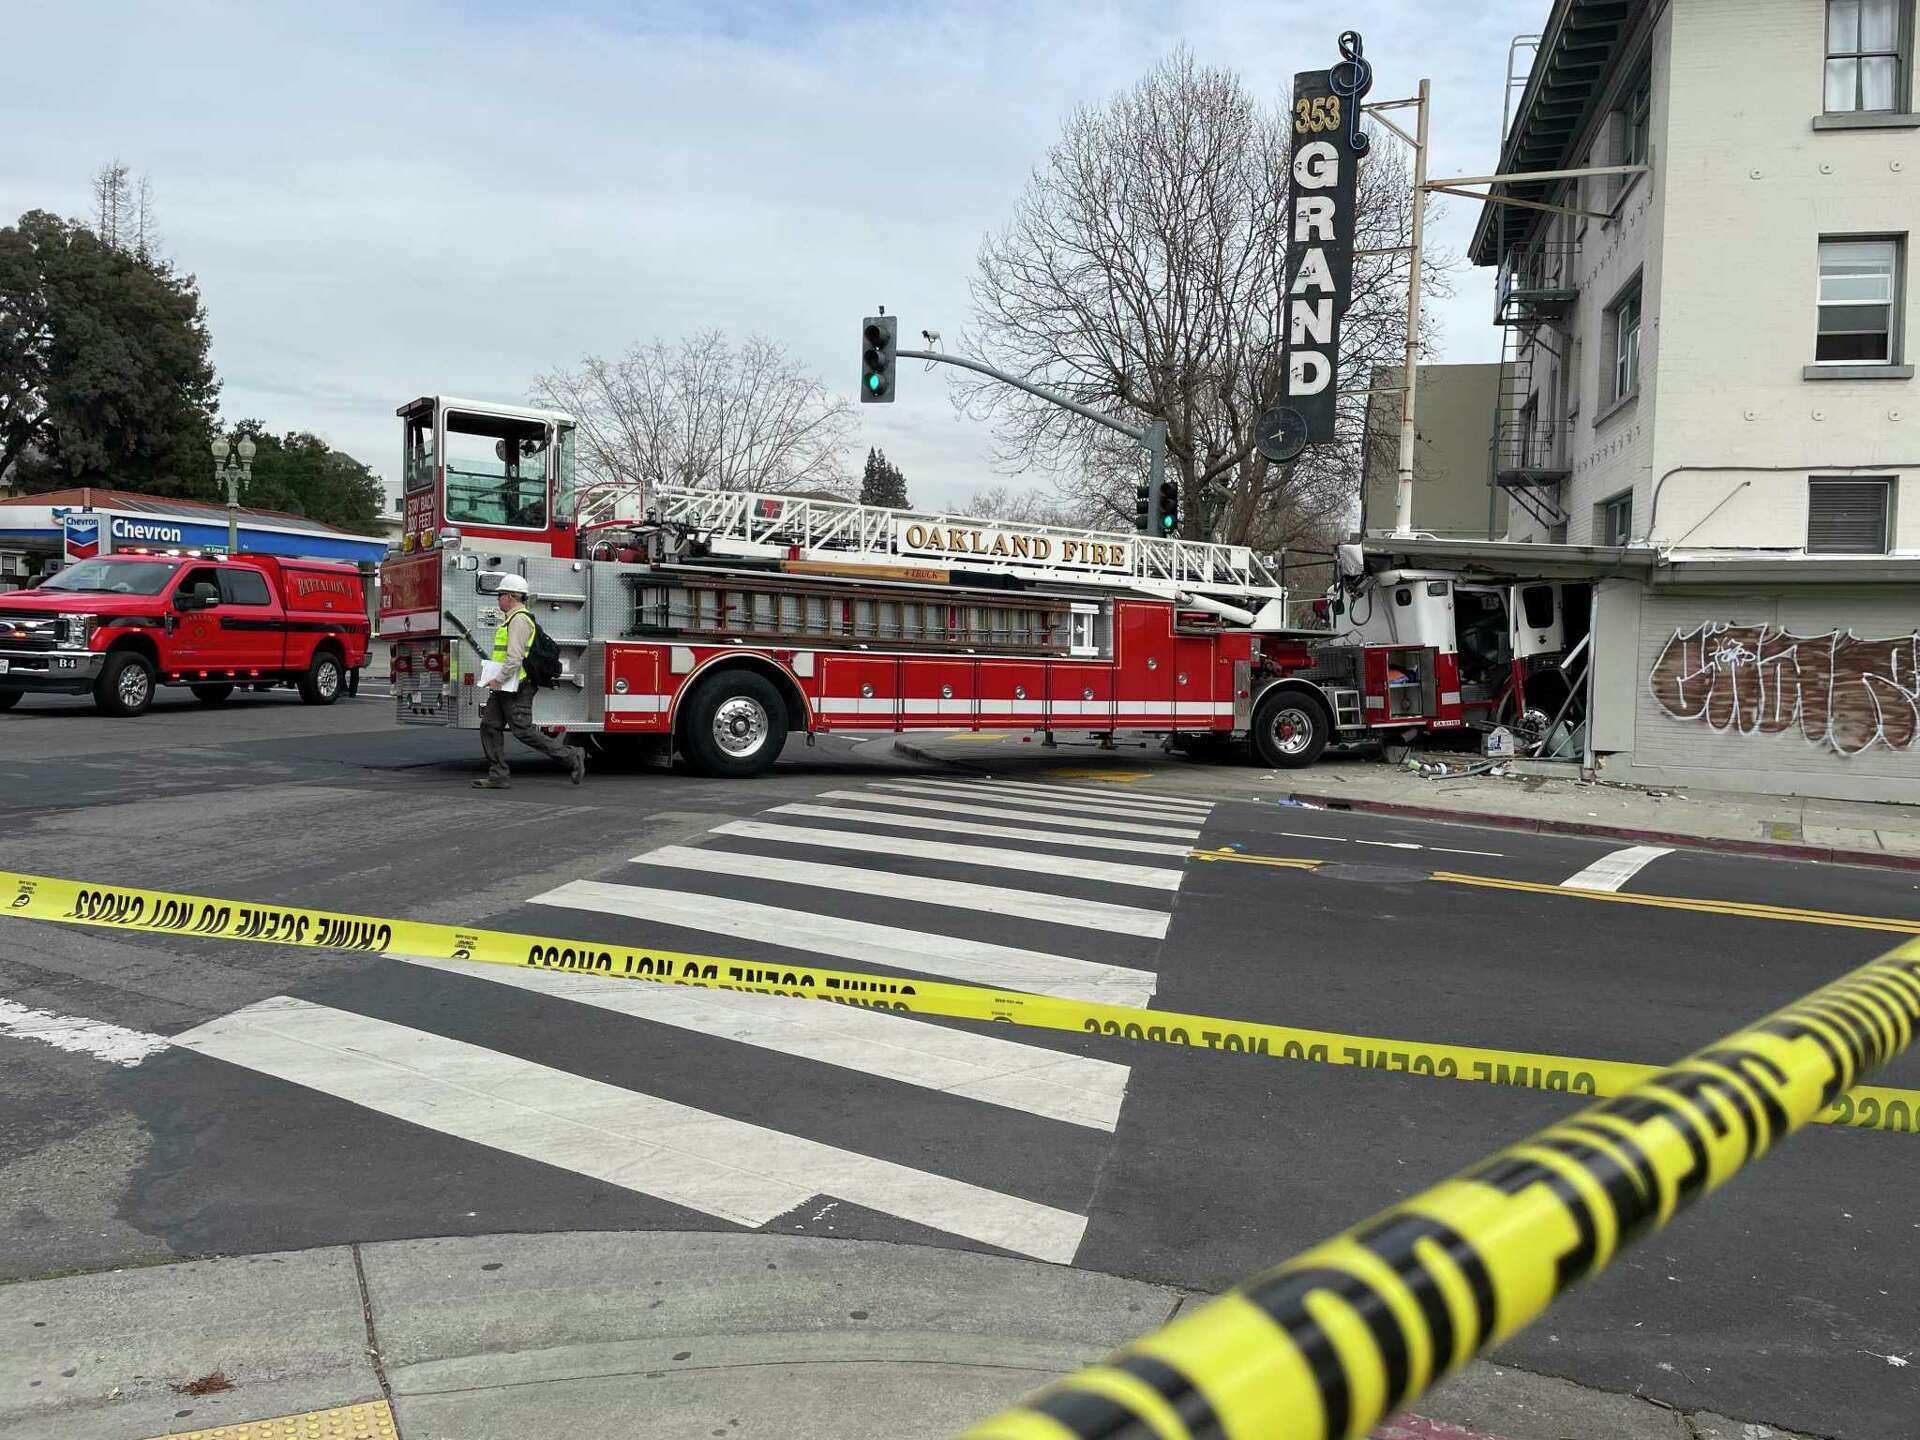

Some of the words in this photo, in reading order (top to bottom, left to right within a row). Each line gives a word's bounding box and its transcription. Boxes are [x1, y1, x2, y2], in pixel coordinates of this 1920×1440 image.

[1295, 94, 1341, 134] 353
[1288, 141, 1339, 397] GRAND
[407, 497, 420, 515] STAY
[420, 492, 435, 511] BACK
[66, 516, 98, 526] Chevron
[112, 518, 181, 542] Chevron
[418, 511, 432, 529] FEET
[906, 524, 1052, 559] OAKLAND
[1062, 539, 1126, 567] FIRE
[297, 577, 345, 597] BATTALION
[911, 568, 938, 580] TRUCK
[59, 659, 76, 668] B4
[64, 889, 145, 925] CROSS
[141, 899, 194, 930] NOT
[191, 904, 231, 936] DO
[234, 909, 310, 945] SCENE
[314, 917, 392, 952] CRIME
